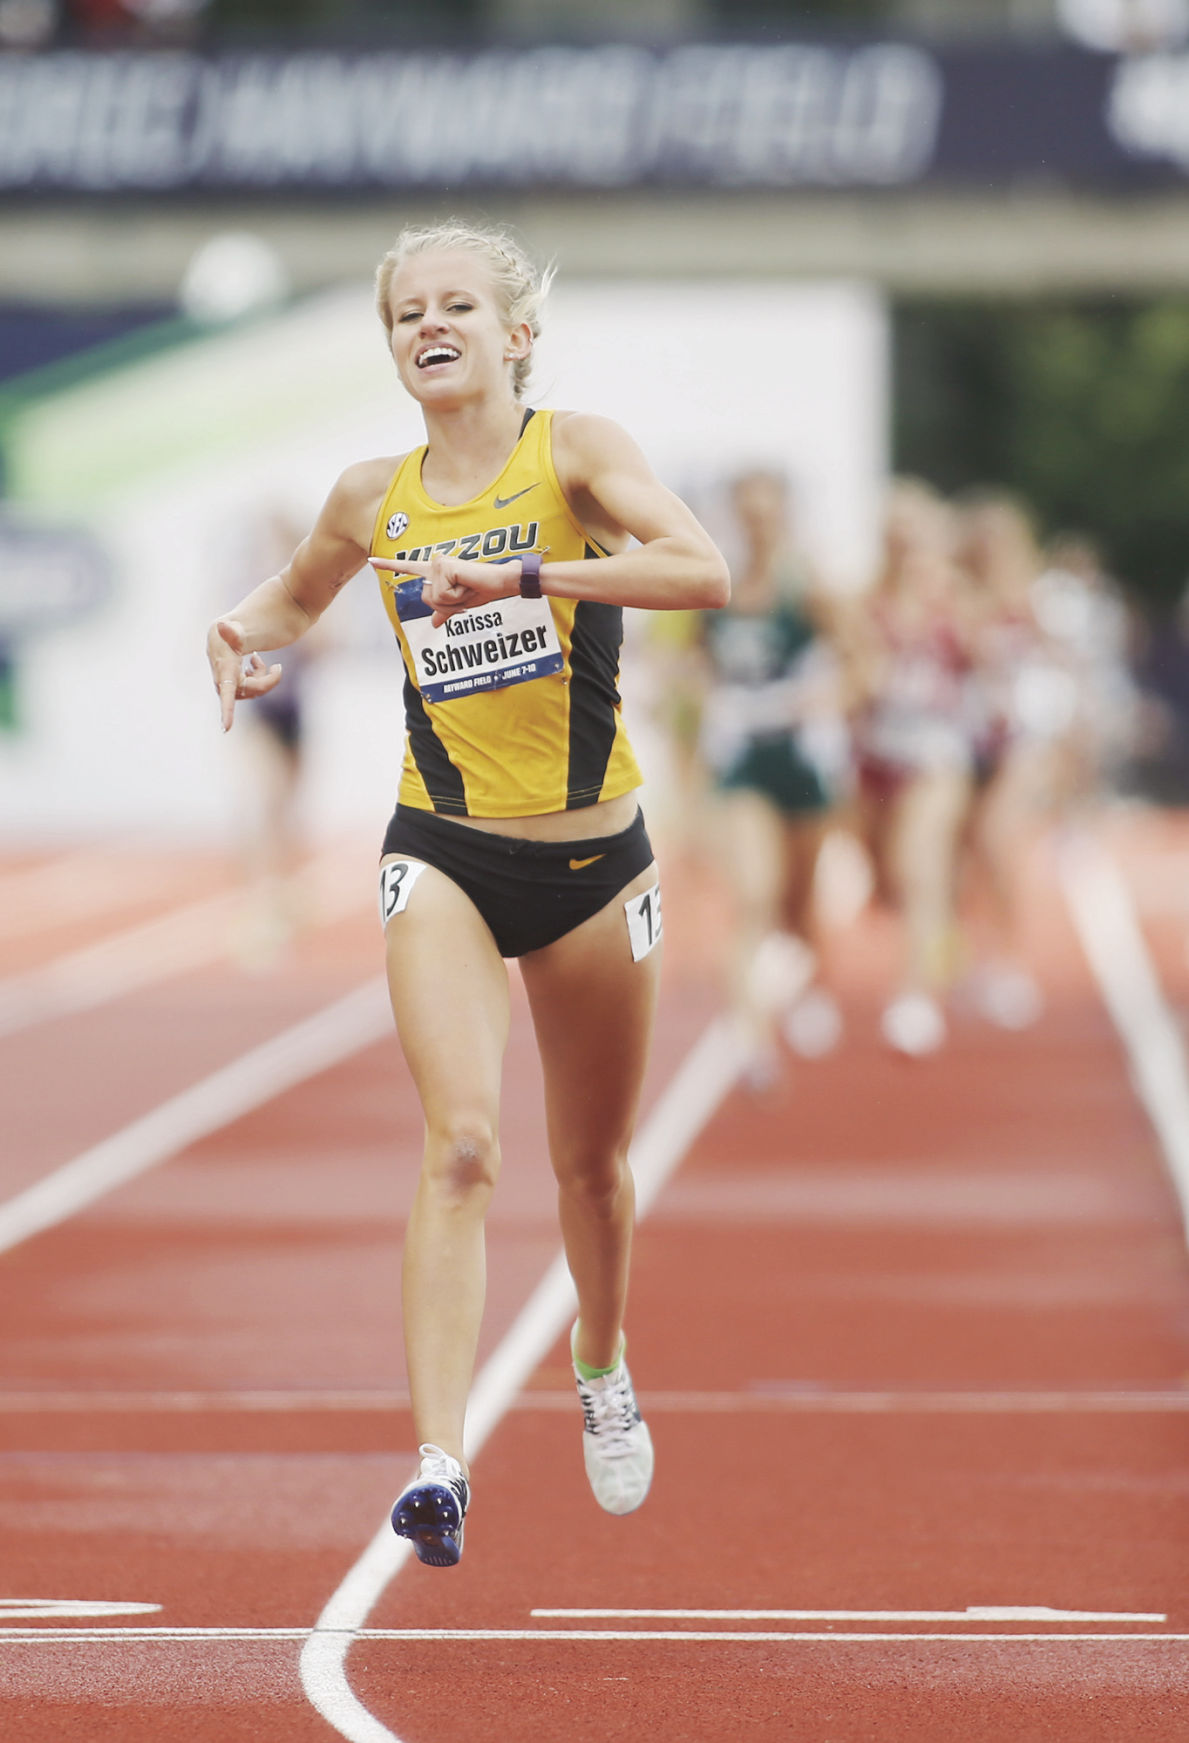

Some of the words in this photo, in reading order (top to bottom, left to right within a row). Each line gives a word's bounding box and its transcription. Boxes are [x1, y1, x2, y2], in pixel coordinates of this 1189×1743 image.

[445, 611, 503, 637] Karissa
[421, 624, 547, 676] Schweizer
[474, 675, 492, 687] FIELD
[502, 667, 521, 680] JUNE
[521, 663, 537, 675] 7-10
[380, 863, 409, 922] 13
